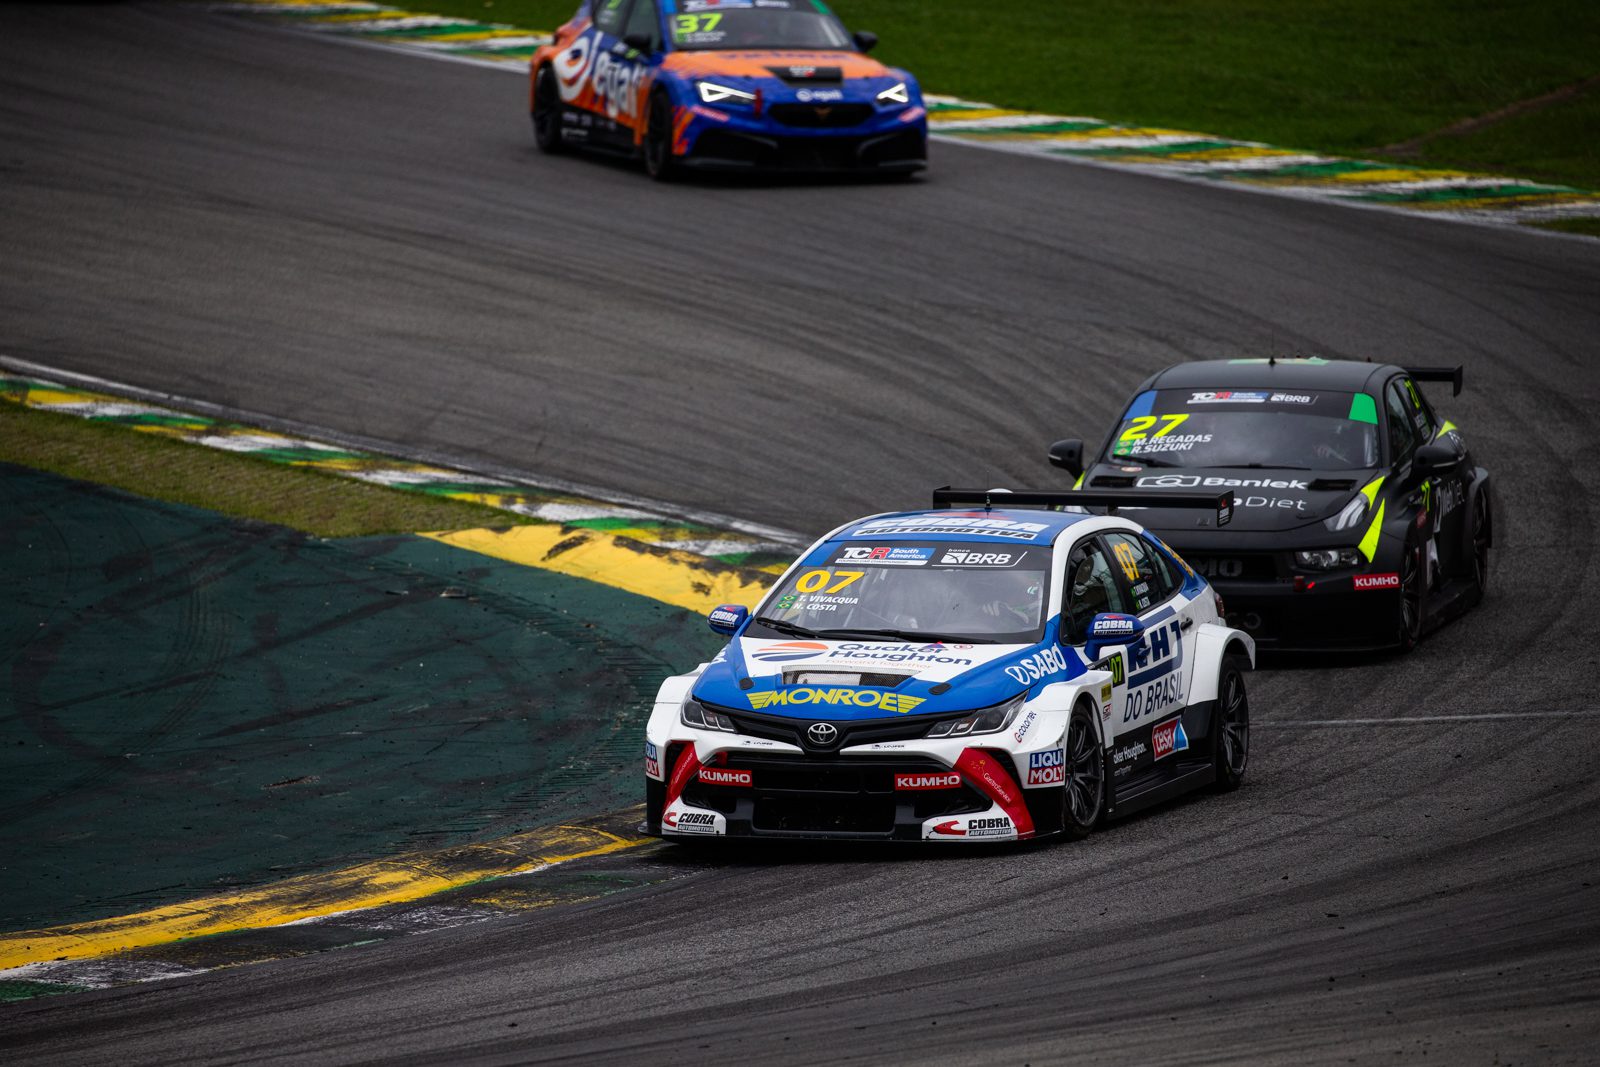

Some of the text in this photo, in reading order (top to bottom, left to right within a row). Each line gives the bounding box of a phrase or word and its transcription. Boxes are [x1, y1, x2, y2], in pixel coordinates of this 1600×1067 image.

[676, 13, 722, 34] 37
[1284, 395, 1310, 403] BRB
[1119, 413, 1190, 441] 27
[862, 517, 1050, 533] COBRA
[843, 547, 891, 559] TCR
[964, 553, 1012, 564] BRB
[1113, 543, 1139, 581] 07
[795, 569, 865, 594] 07
[1355, 575, 1399, 588] KUMHO
[809, 595, 859, 605] VIVACQUA
[806, 603, 837, 612] COSTA
[710, 610, 739, 623] COBRA
[1094, 620, 1133, 630] COBRA
[828, 650, 972, 666] Houghton
[1110, 655, 1122, 684] 07
[761, 687, 899, 712] MONROE
[1123, 689, 1142, 724] DO
[1144, 671, 1184, 716] BRASIL
[1153, 728, 1173, 753] tesa
[1031, 749, 1063, 768] LIQUI
[699, 770, 751, 783] KUMHO
[897, 775, 960, 787] KUMHO
[1029, 766, 1064, 784] MOLY
[679, 813, 716, 825] COBRA
[968, 817, 1011, 830] COBRA
